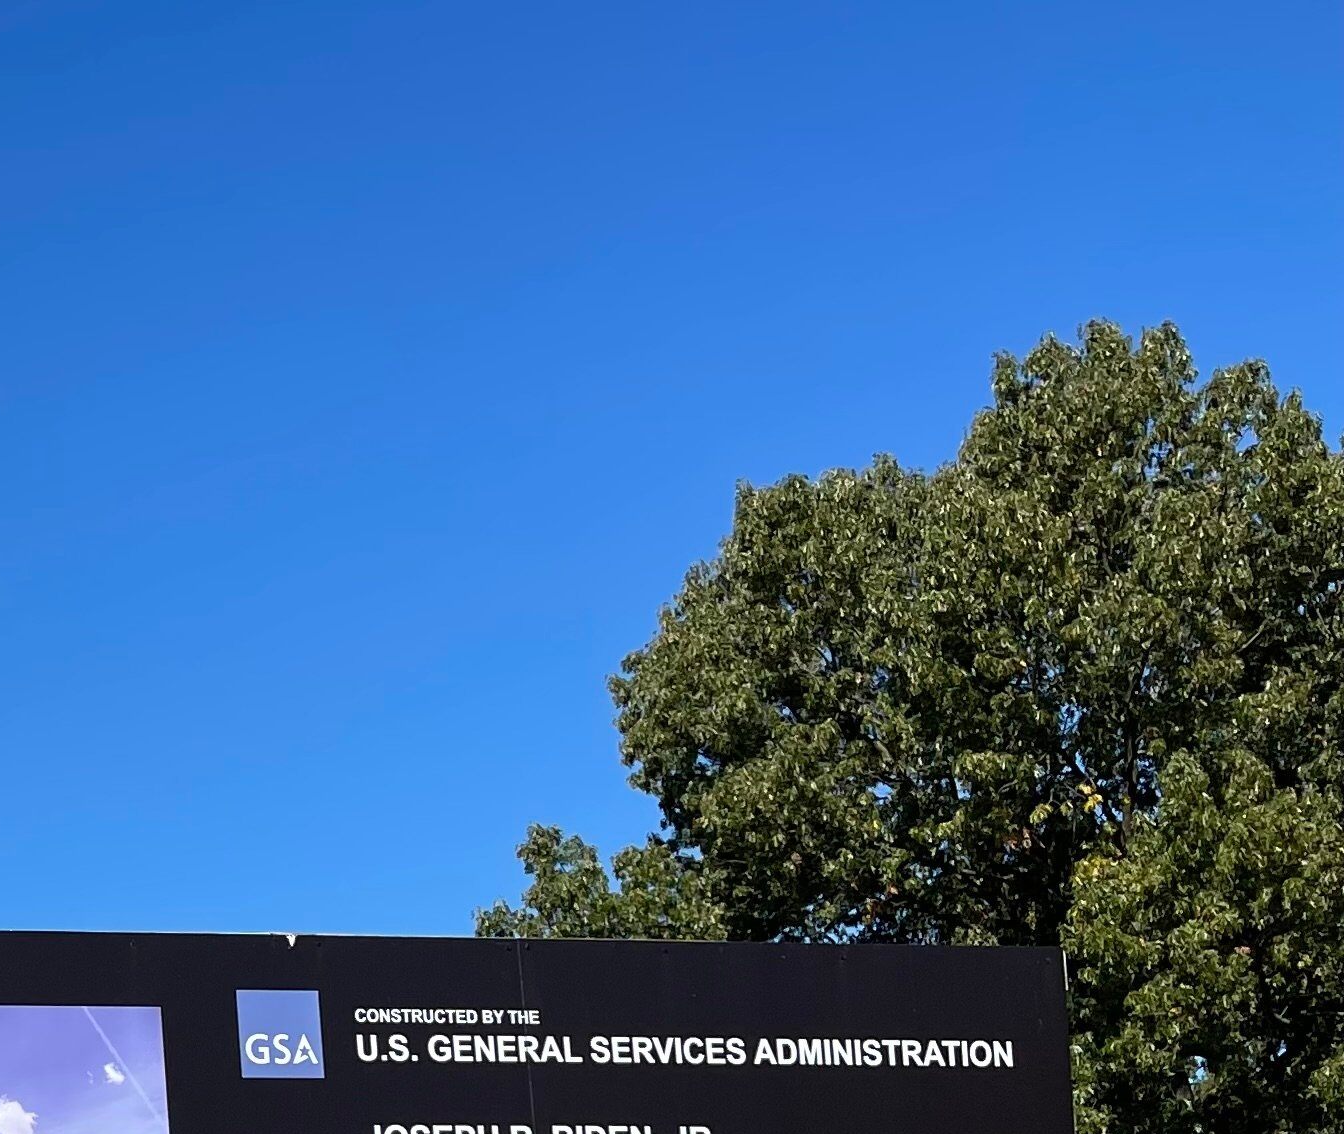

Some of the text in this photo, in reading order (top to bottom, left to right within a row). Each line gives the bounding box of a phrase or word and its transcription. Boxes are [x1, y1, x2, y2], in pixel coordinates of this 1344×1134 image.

[354, 1008, 541, 1025] CONSTRUCTED BY THE
[245, 1033, 319, 1065] GSA
[355, 1033, 1014, 1068] U.S. GENERAL SERVICES ADMINISTRATION
